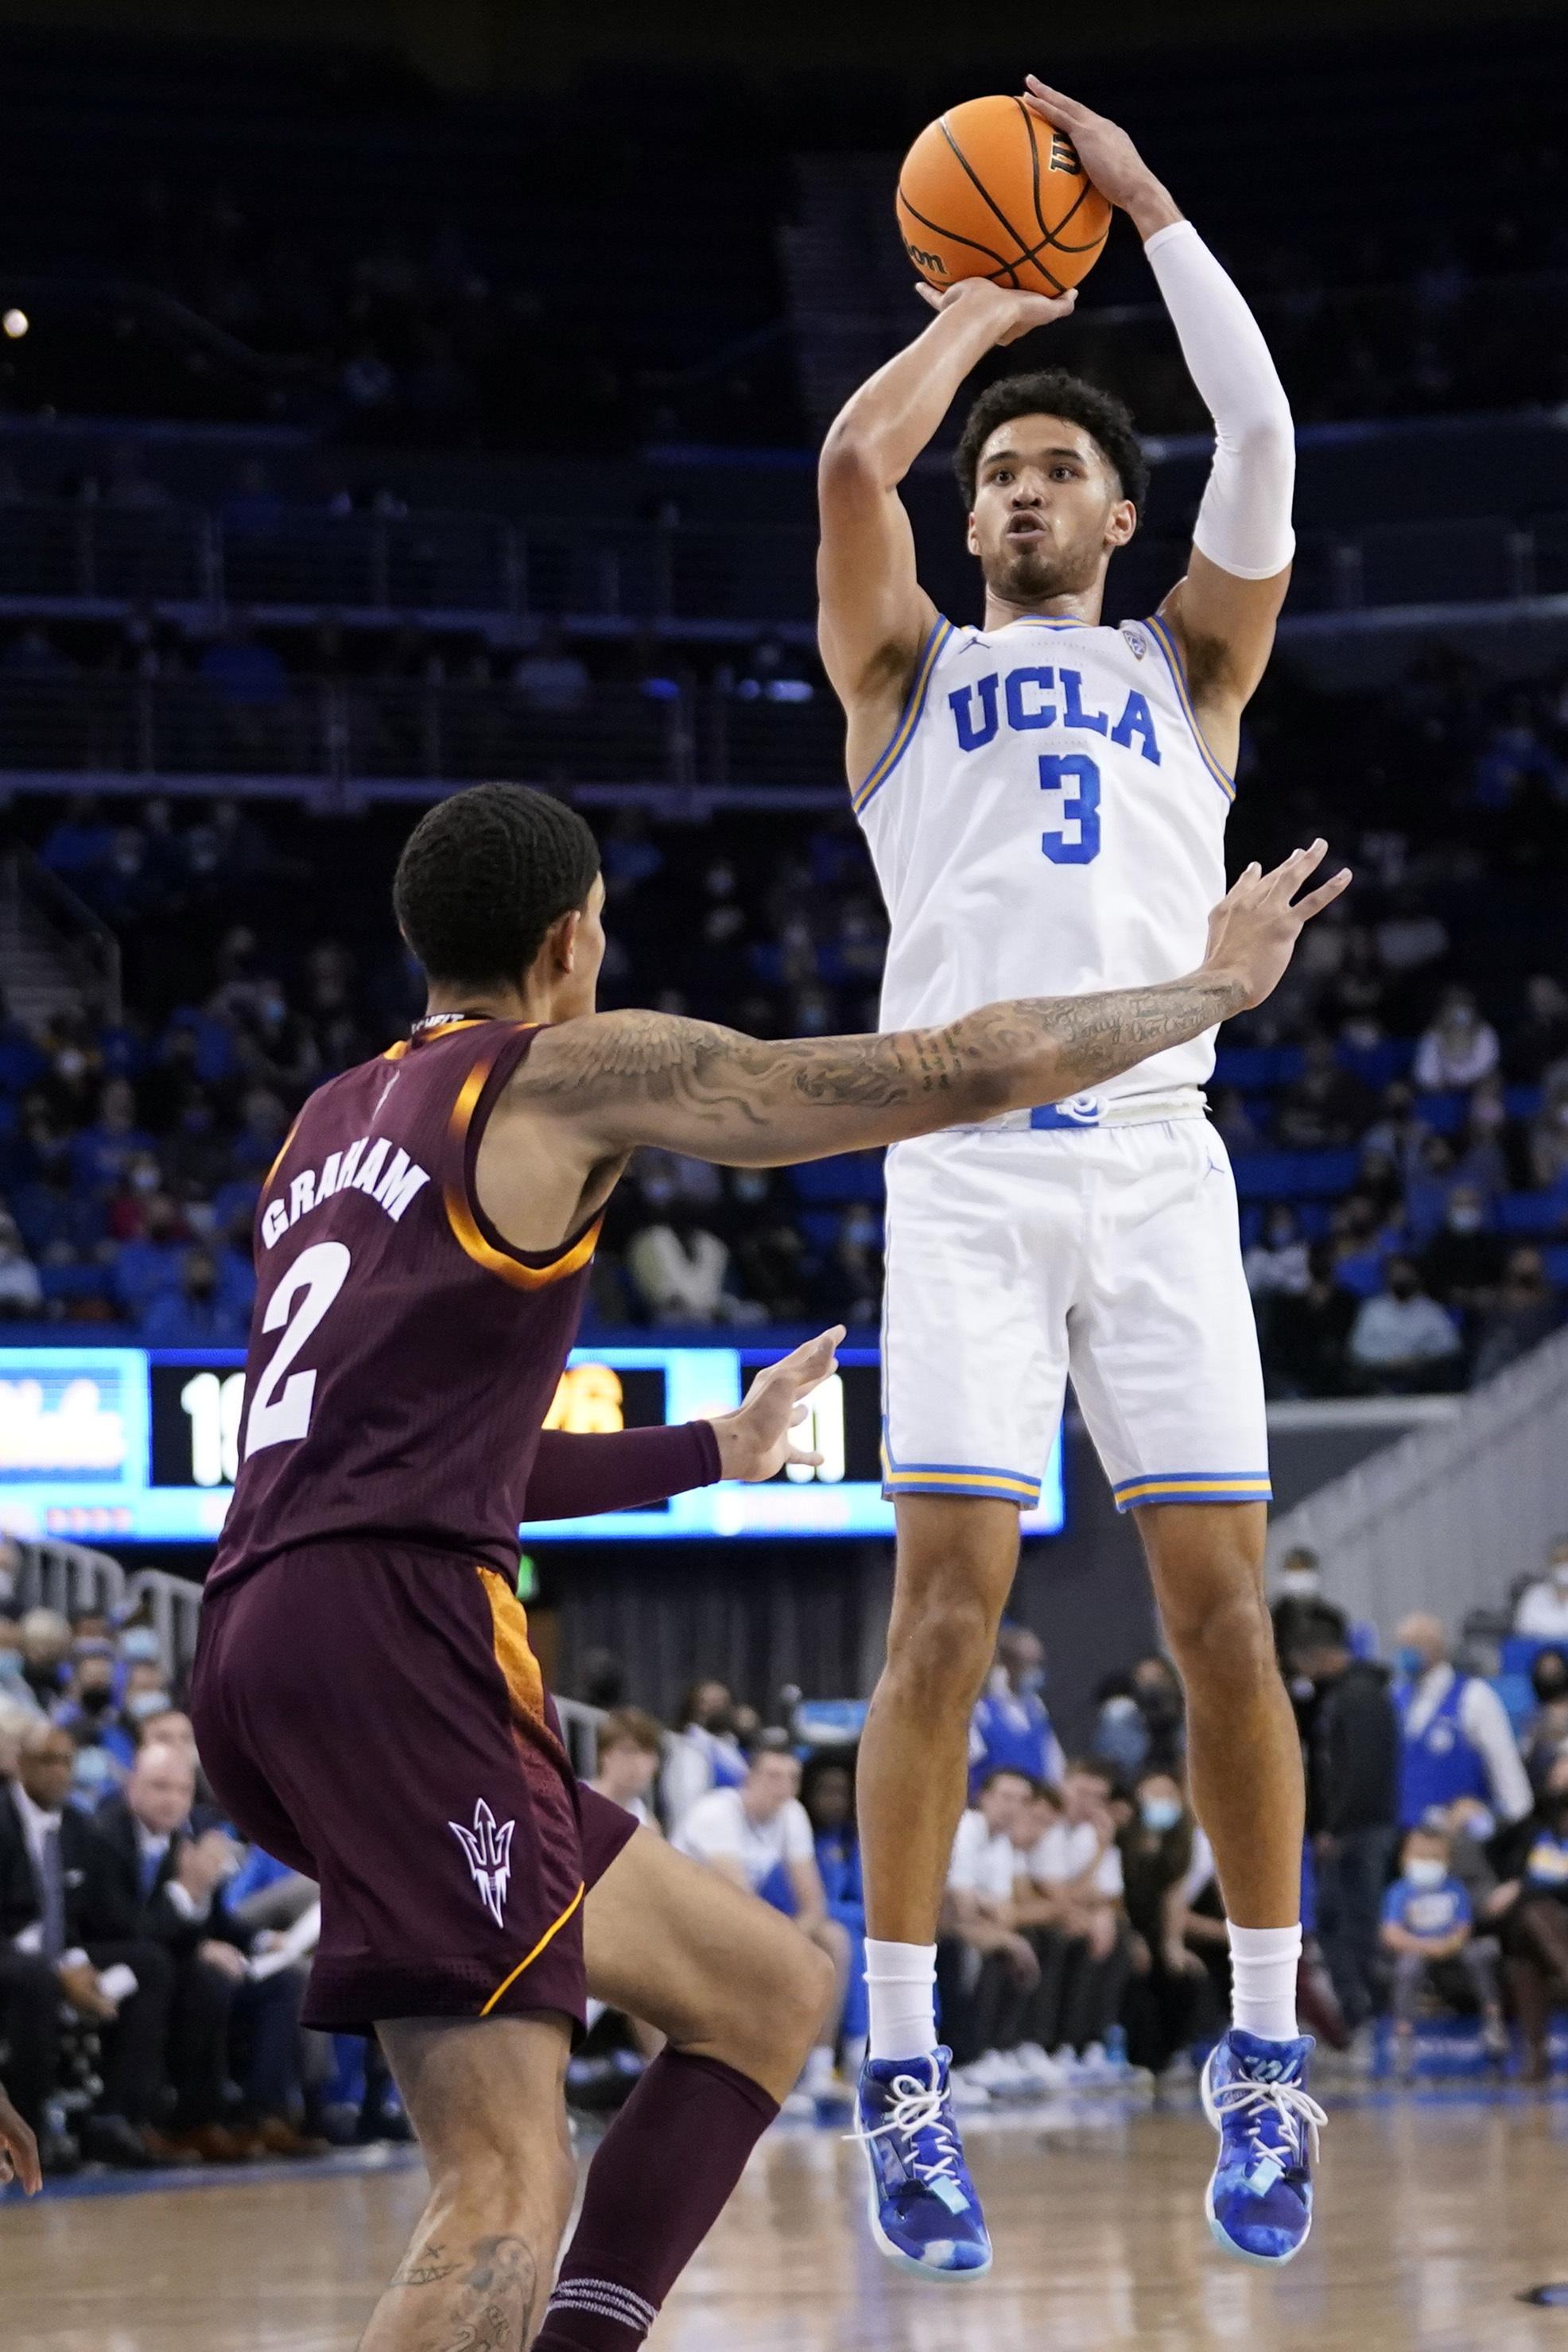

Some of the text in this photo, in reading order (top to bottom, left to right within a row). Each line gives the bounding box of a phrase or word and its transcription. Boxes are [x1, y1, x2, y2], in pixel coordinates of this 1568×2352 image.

[949, 666, 1162, 767] UCLA
[1038, 754, 1101, 864] 3
[261, 1136, 431, 1249] GRAHAM
[244, 1241, 351, 1462] 2
